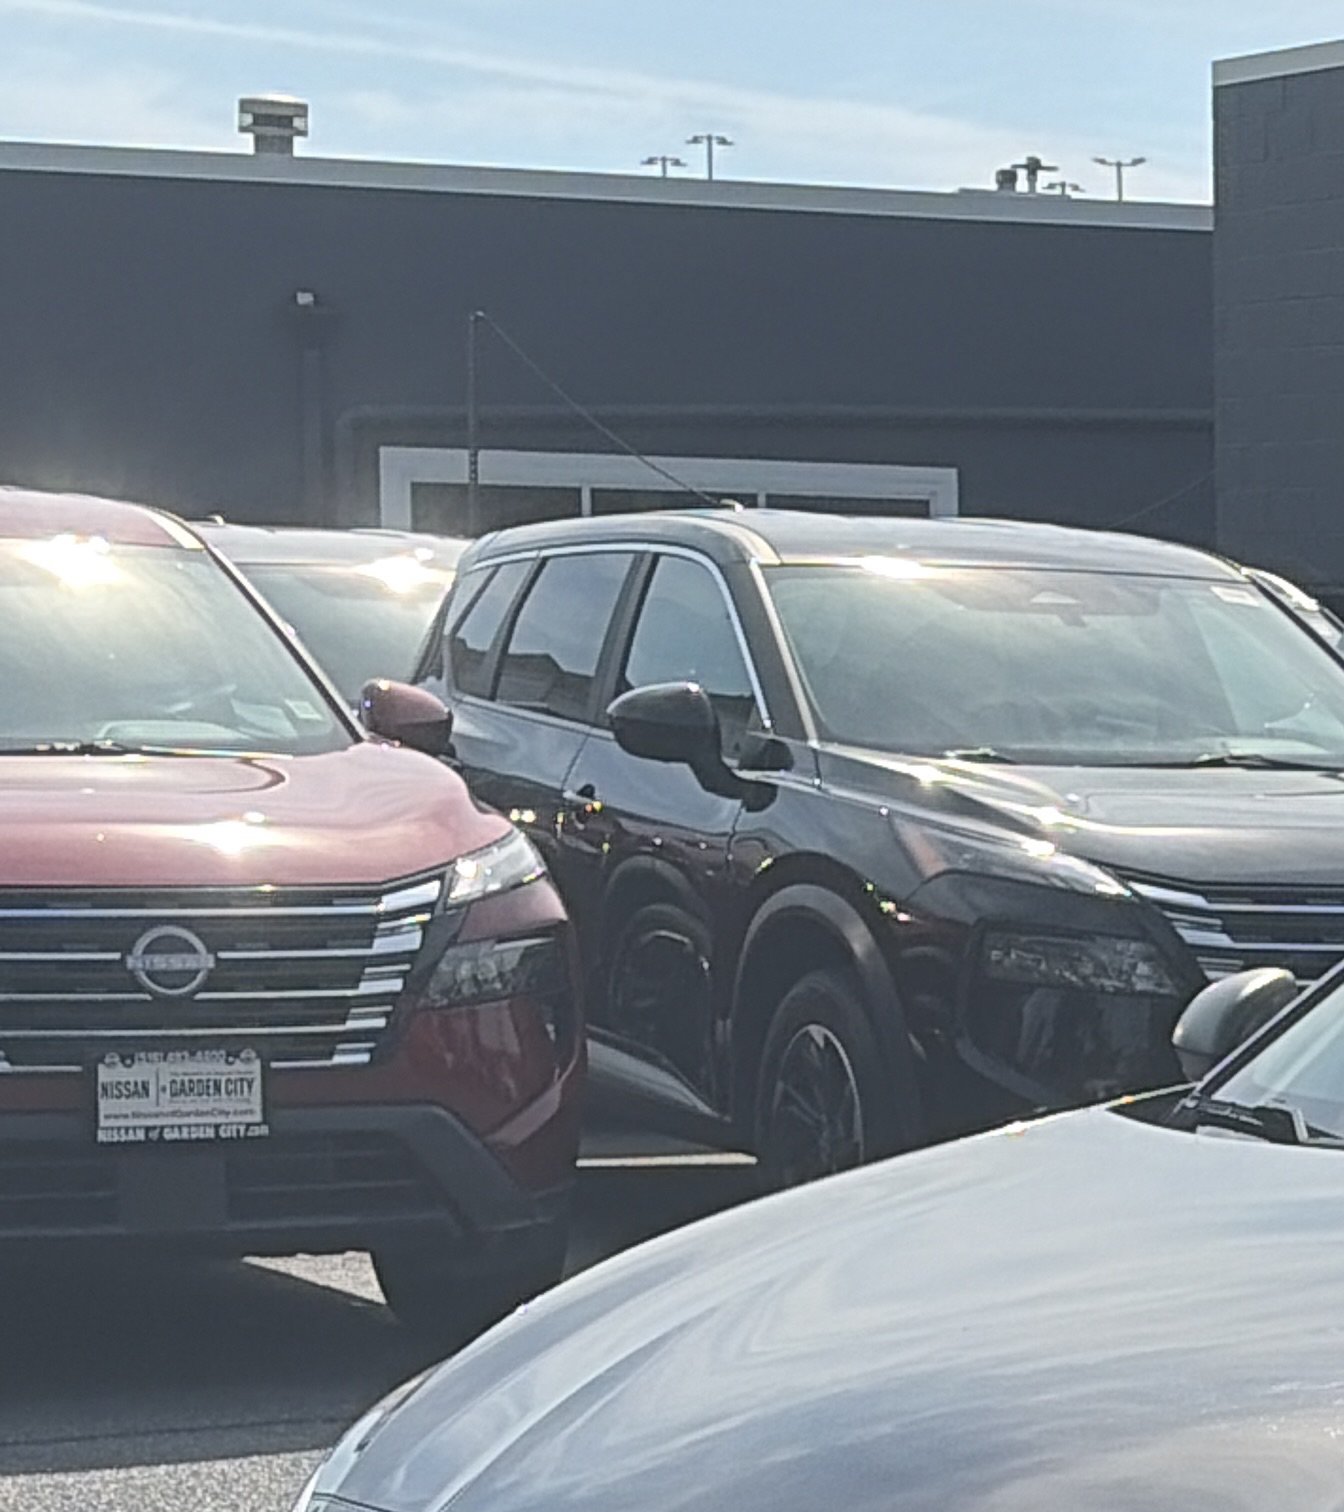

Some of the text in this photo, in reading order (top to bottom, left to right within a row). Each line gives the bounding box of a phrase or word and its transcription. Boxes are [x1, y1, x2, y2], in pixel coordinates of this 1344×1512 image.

[100, 1080, 150, 1100] NISSAN
[169, 1078, 222, 1098] GARDEN
[224, 1077, 255, 1096] CITY
[97, 1127, 146, 1143] NISSAN
[163, 1125, 215, 1141] GARDEN
